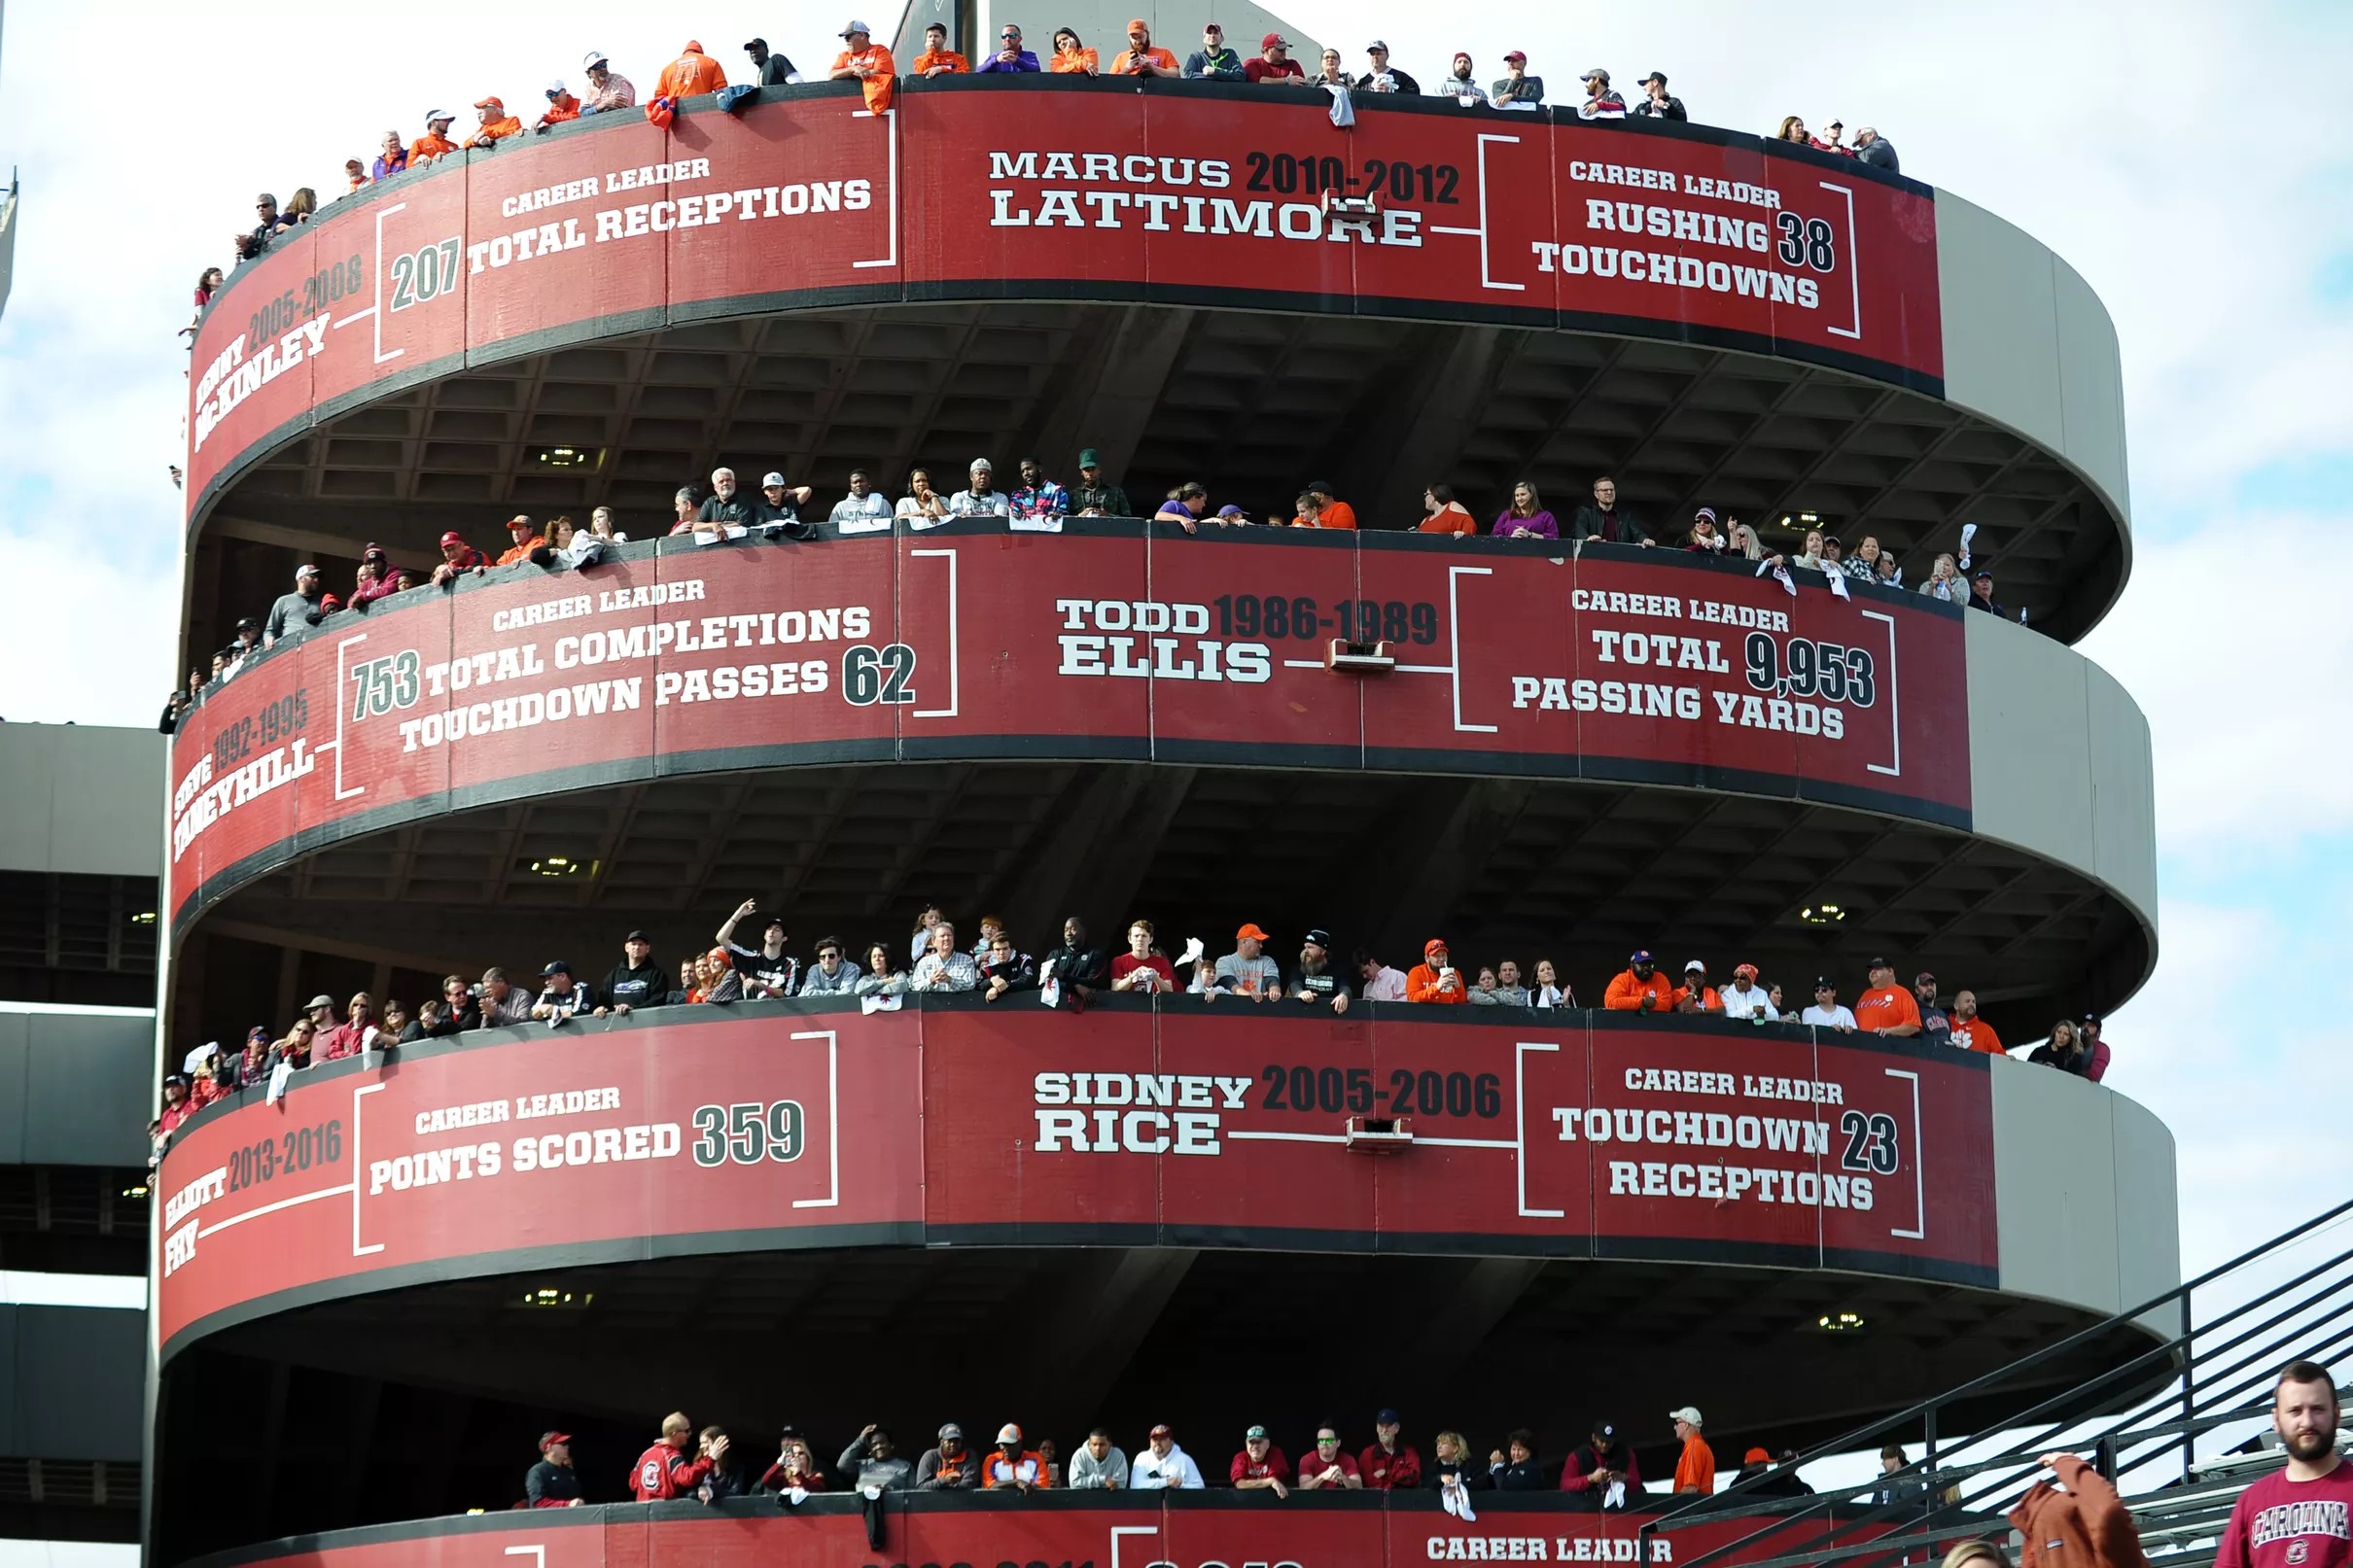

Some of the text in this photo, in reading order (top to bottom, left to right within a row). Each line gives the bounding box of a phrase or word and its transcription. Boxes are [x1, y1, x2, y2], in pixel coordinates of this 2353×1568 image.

[502, 157, 710, 218] CAREER LEADER
[988, 151, 1458, 204] MARCUS 2010-2012
[1569, 160, 1781, 210] CAREER LEADER
[466, 179, 871, 275] TOTAL RECEPTIONS
[1586, 198, 1769, 254] RUSHING
[1776, 211, 1835, 273] 38
[249, 254, 362, 352] 2005-2008
[390, 235, 462, 313] 207
[1531, 241, 1819, 309] TOUCHDOWNS
[493, 579, 706, 632] CAREER LEADER
[1055, 594, 1437, 645] TODD 1986-1989
[1571, 589, 1789, 634] CAREER LEADER
[425, 607, 871, 697] TOTAL COMPLETIONS
[841, 644, 916, 707] 62
[1057, 635, 1272, 683] ELLIS
[1592, 629, 1730, 674] TOTAL
[1745, 632, 1876, 709] 9,953
[351, 648, 421, 722] 753
[399, 660, 828, 753] TOUCHDOWN PASSES
[1511, 676, 1844, 740] PASSING YARDS
[213, 688, 308, 774] 1992-1995
[415, 1086, 620, 1135] CAREER LEADER
[1033, 1064, 1501, 1119] SIDNEY 2005-2006
[1625, 1067, 1844, 1106] CAREER LEADER
[229, 1119, 342, 1193] 2013-2016
[369, 1122, 681, 1196] POINTS SCORED
[691, 1098, 805, 1168] 359
[1033, 1109, 1221, 1156] RICE
[1552, 1107, 1830, 1156] TOUCHDOWN
[1841, 1109, 1899, 1175] 23
[1608, 1161, 1874, 1211] RECEPTIONS
[164, 1217, 199, 1278] FRY
[1426, 1536, 1548, 1561] CAREER
[2252, 1500, 2351, 1550] CAROLINA
